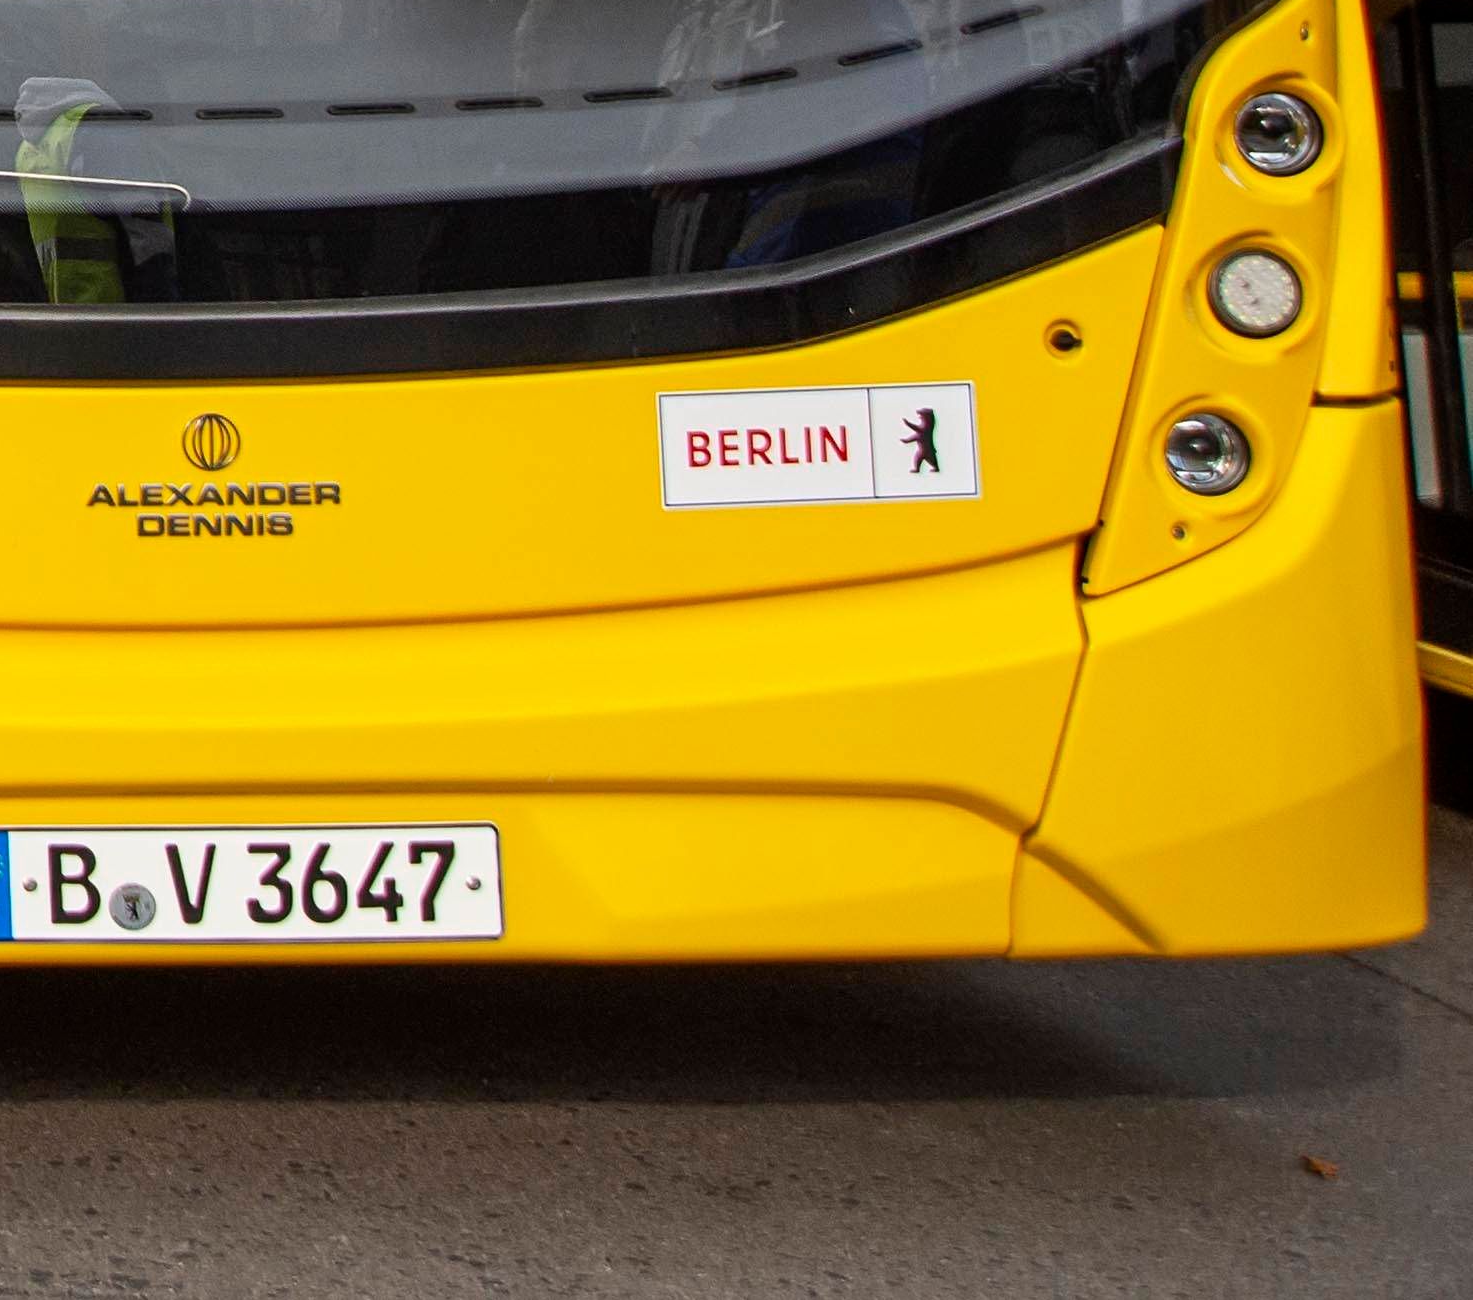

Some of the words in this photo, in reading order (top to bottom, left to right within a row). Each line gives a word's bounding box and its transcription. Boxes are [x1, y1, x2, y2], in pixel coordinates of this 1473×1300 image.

[685, 424, 849, 469] BERLIN
[86, 481, 342, 507] ALEXANDER
[136, 512, 294, 537] DENNIS
[47, 842, 101, 925] B
[164, 842, 216, 925] V
[247, 840, 456, 925] 3647
